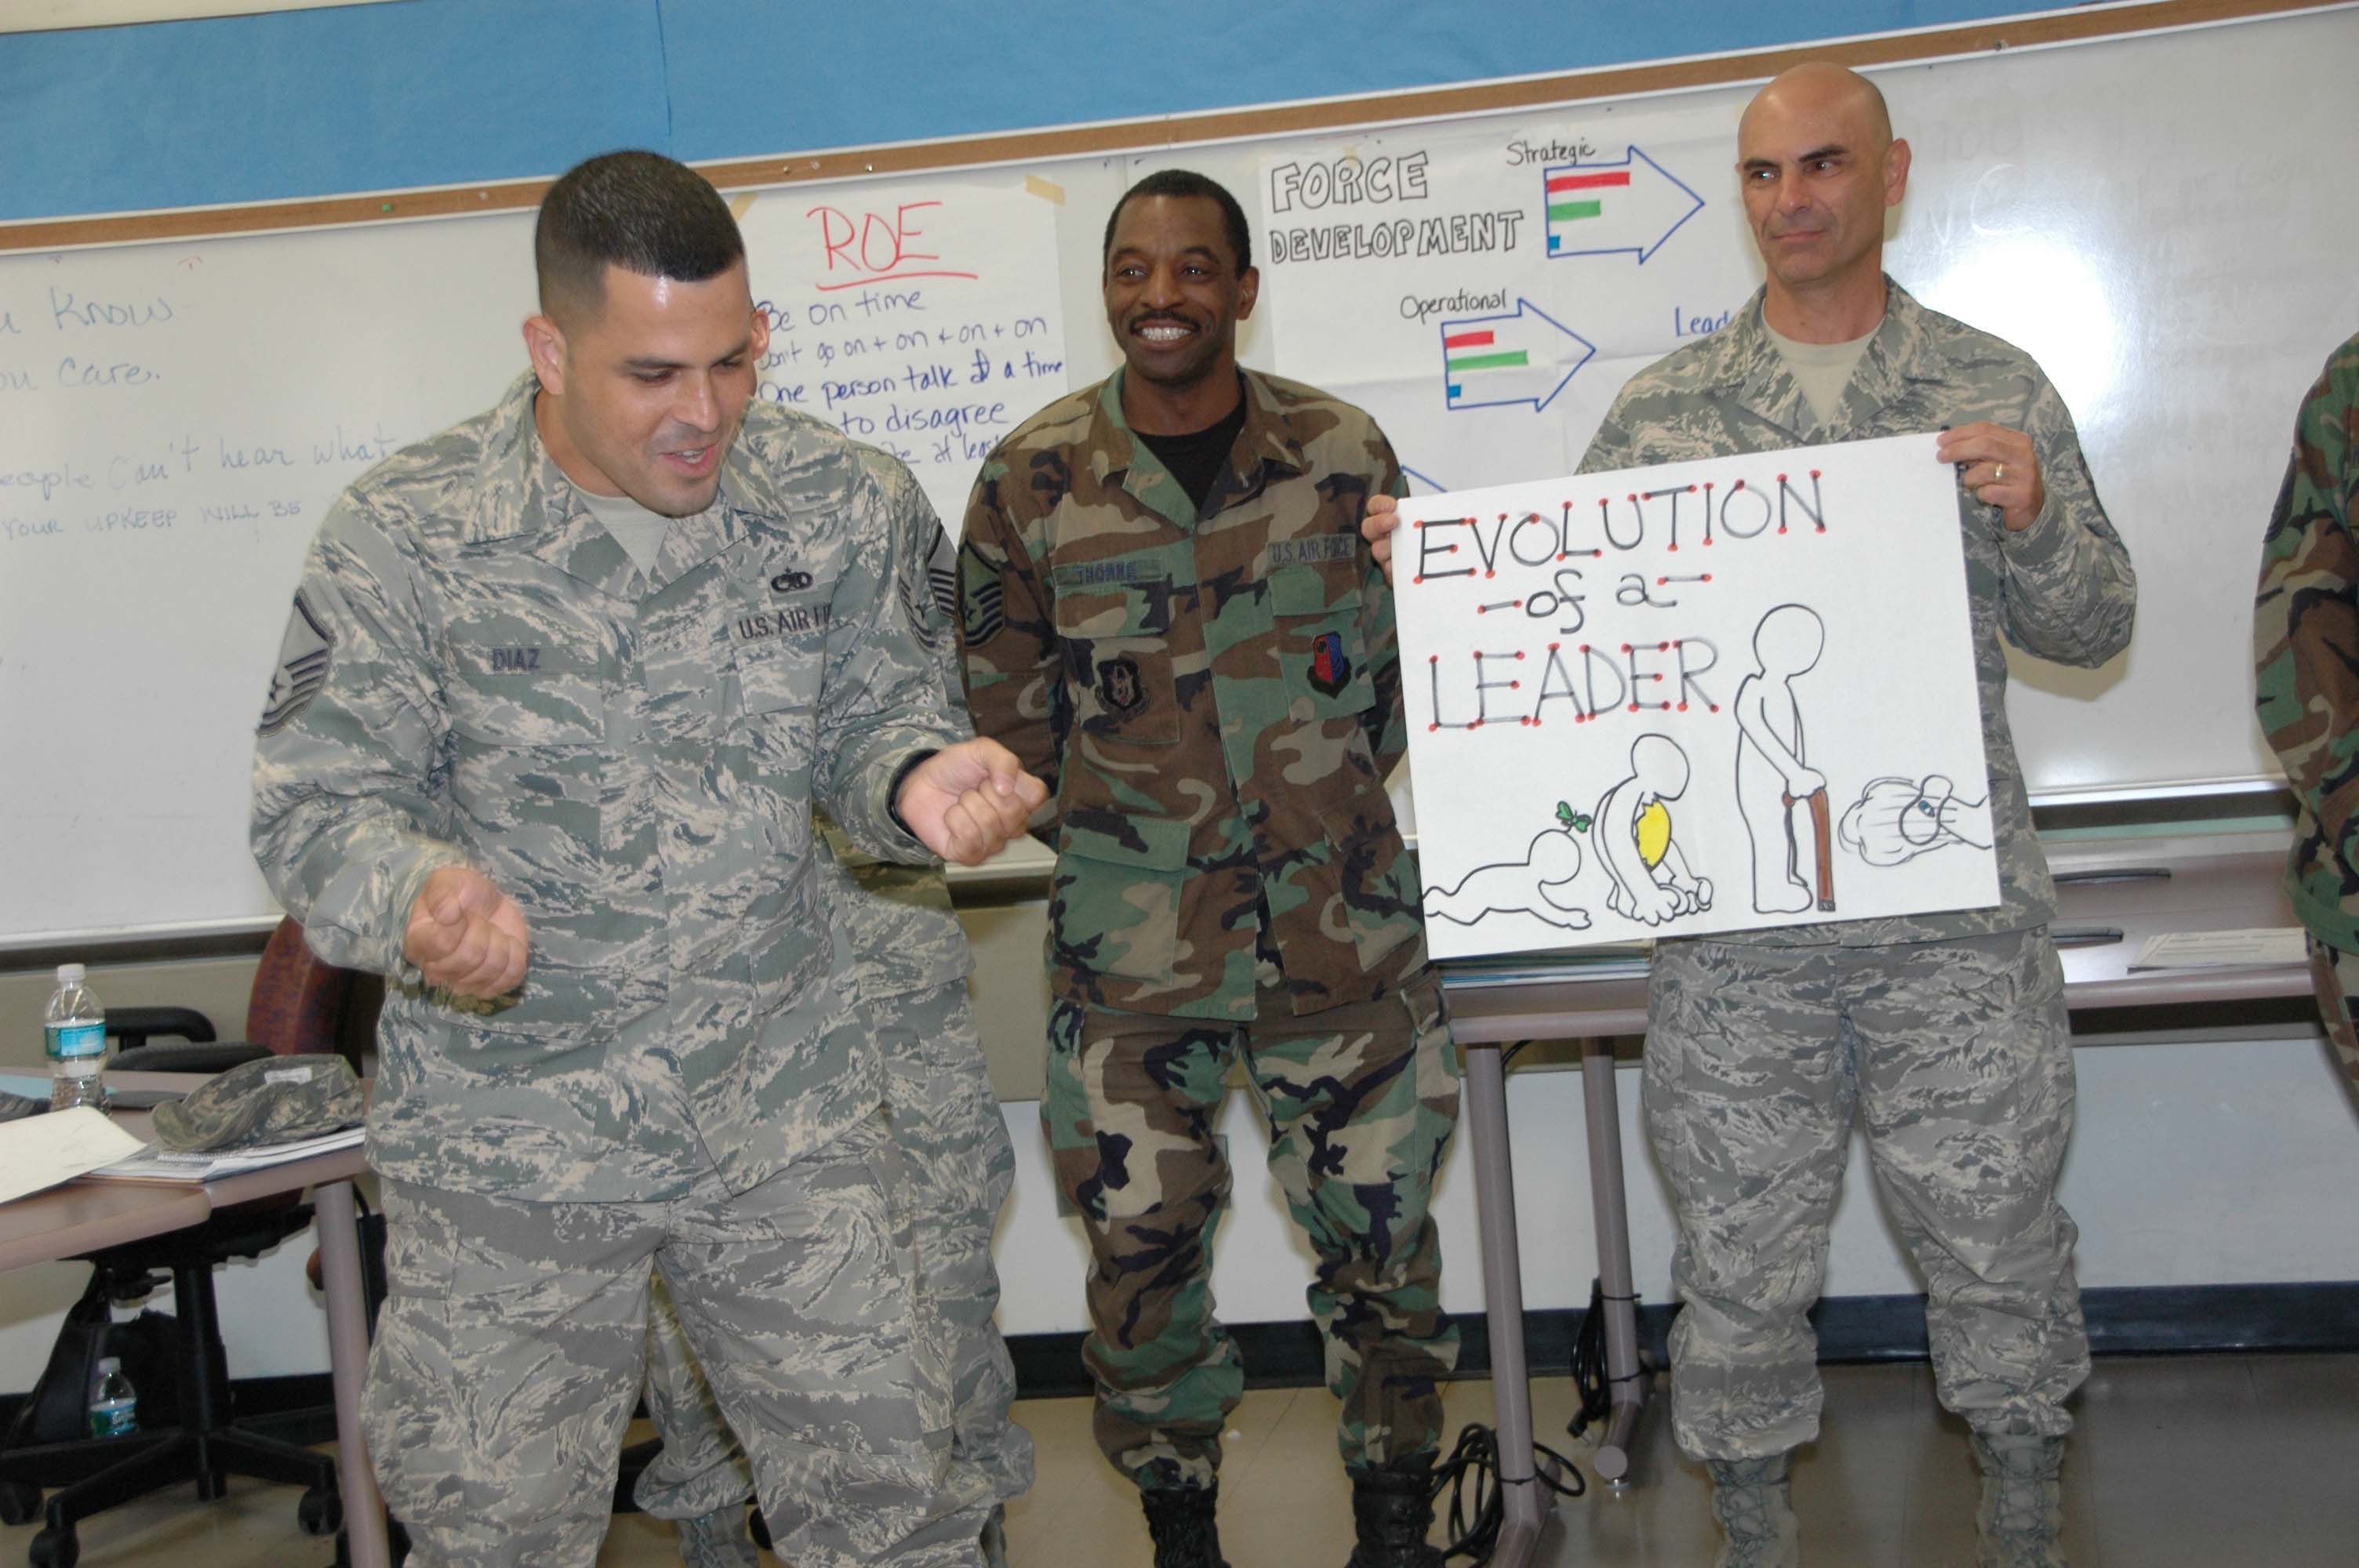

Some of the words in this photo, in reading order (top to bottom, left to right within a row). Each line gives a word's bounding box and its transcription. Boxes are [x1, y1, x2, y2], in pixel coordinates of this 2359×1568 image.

[1506, 137, 1596, 167] Strategic
[1270, 151, 1429, 213] FORCE
[806, 201, 943, 272] ROE
[1269, 209, 1525, 265] DEVELOPMENT
[855, 290, 928, 317] time
[1400, 288, 1507, 325] Operational
[816, 342, 835, 368] go
[844, 338, 867, 357] on
[896, 330, 929, 351] on
[958, 323, 987, 344] on
[1014, 316, 1048, 339] on
[759, 380, 809, 404] One
[821, 377, 896, 411] person
[902, 363, 958, 393] talk
[1004, 360, 1016, 379] a
[1022, 350, 1063, 379] time
[219, 437, 296, 469] hear
[314, 420, 395, 466] what
[841, 412, 875, 434] to
[886, 402, 1010, 438] disagree
[2, 517, 64, 540] YOUR
[267, 499, 302, 518] BE
[1414, 469, 1826, 583] EVOLUTION
[777, 607, 812, 634] AIR
[492, 648, 540, 672] DIAZ
[1428, 636, 1724, 731] LEADER
